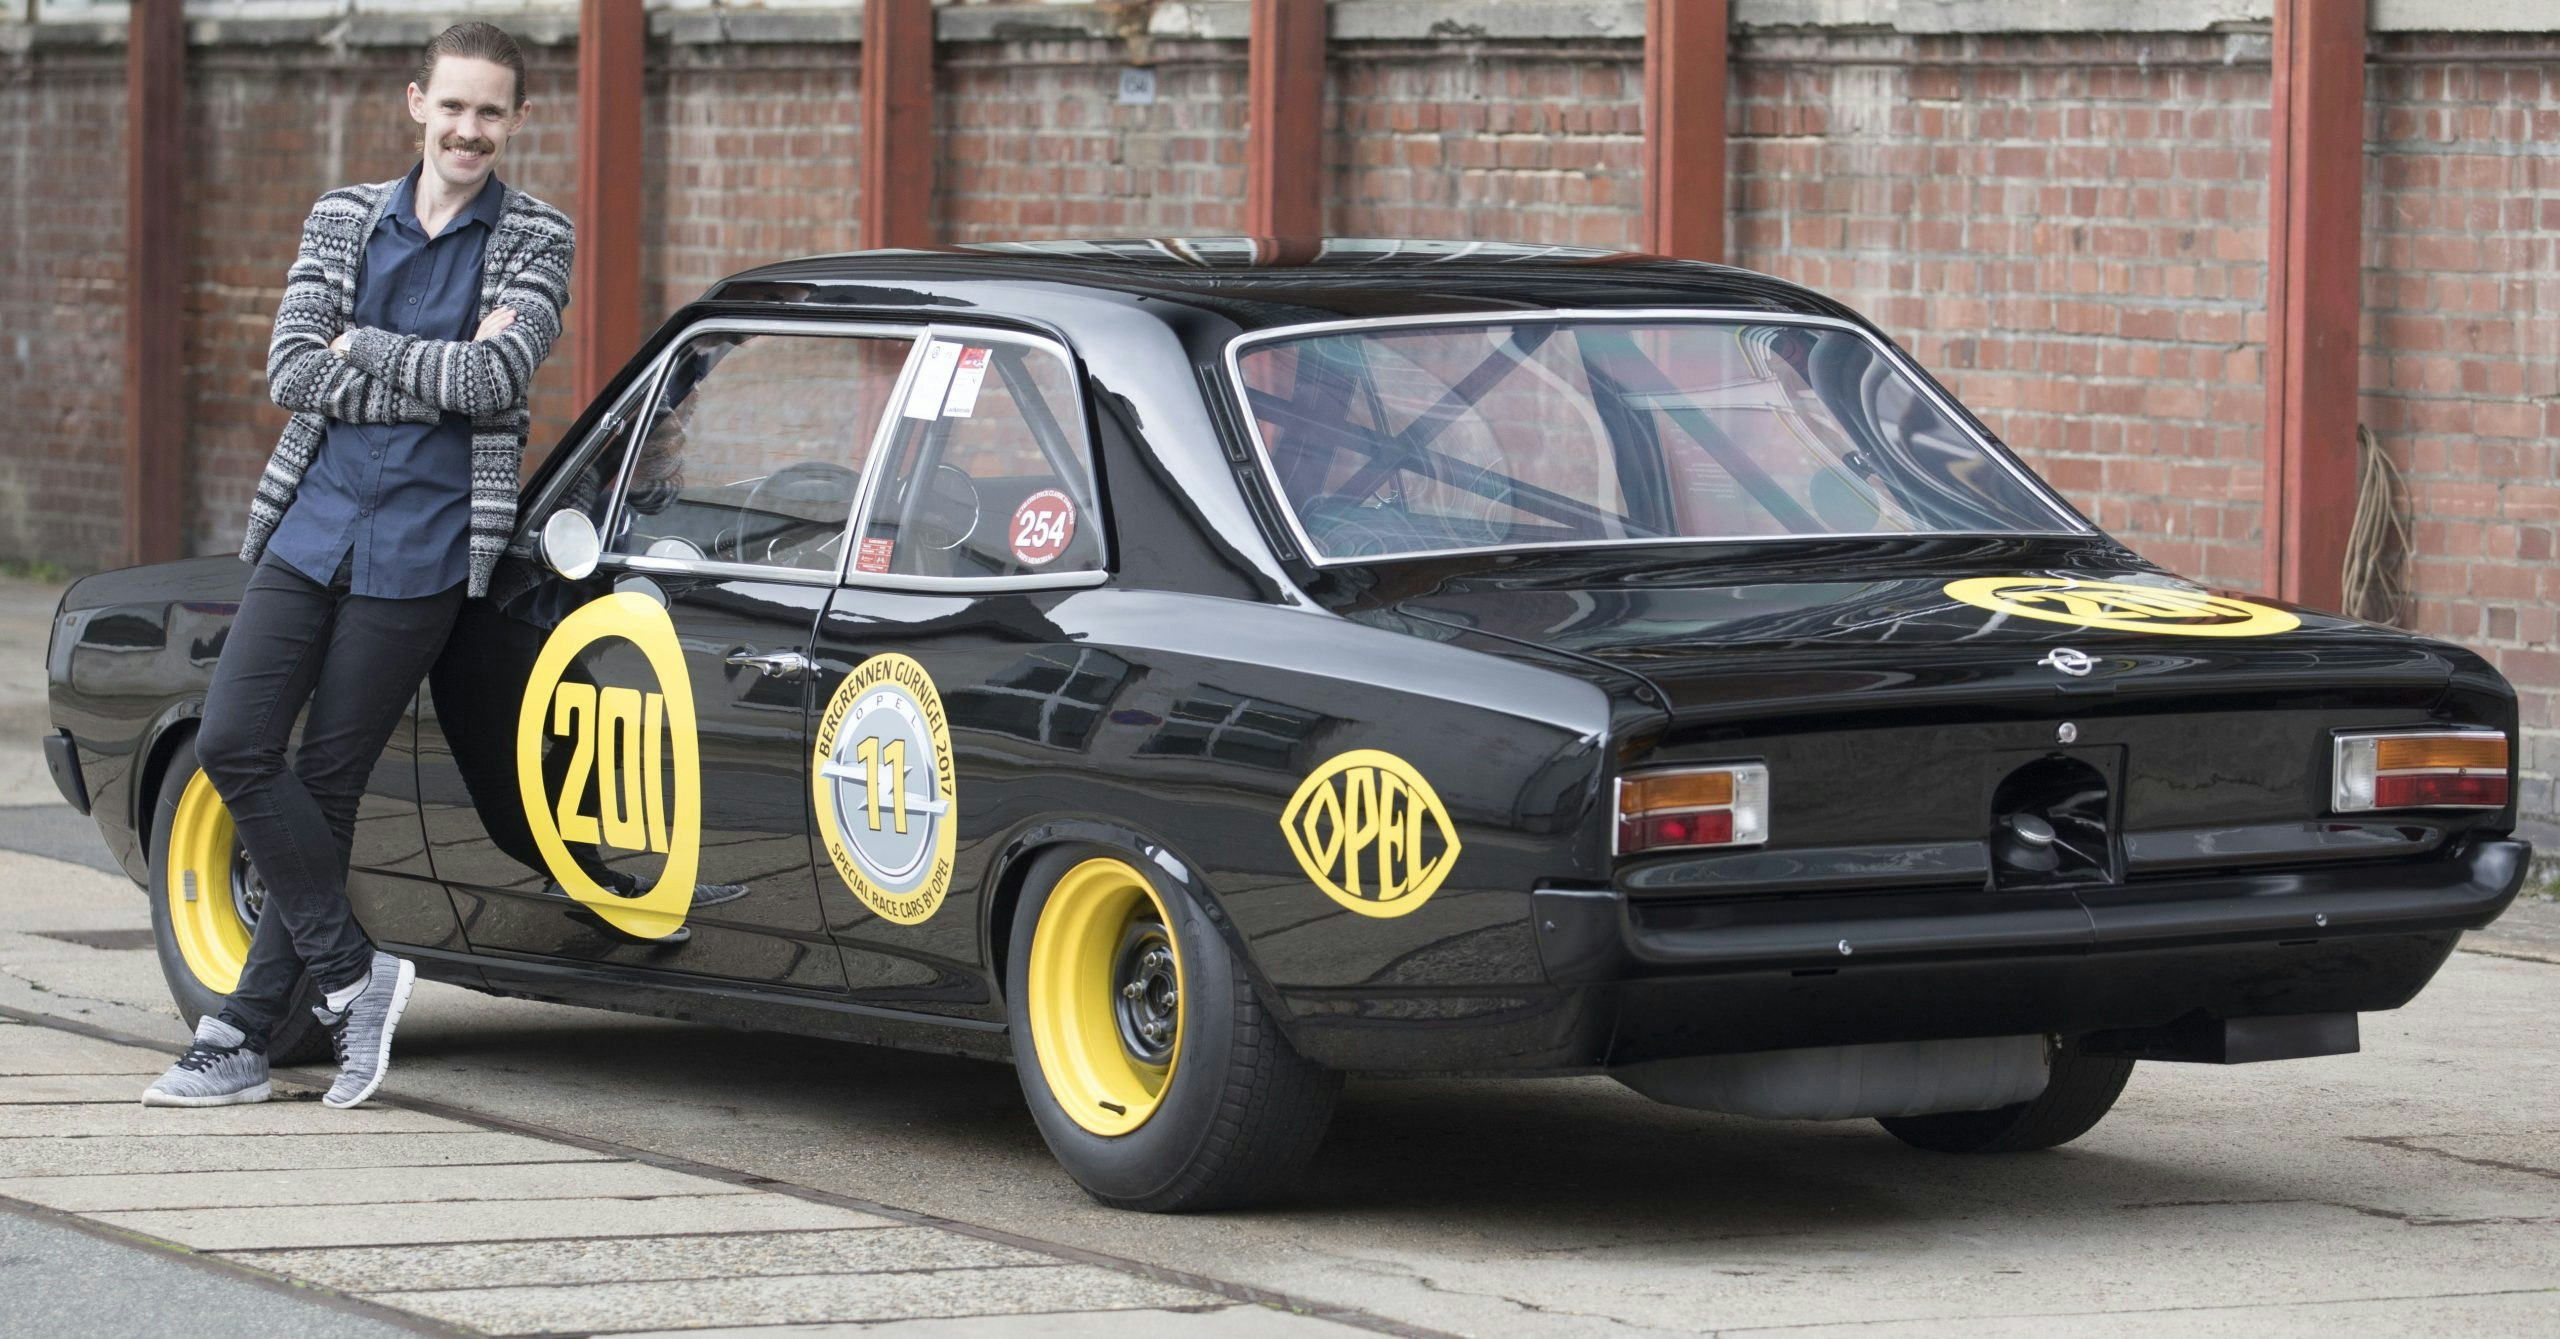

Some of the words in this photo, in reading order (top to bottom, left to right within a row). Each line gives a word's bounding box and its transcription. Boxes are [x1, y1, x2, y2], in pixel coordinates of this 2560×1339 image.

[1015, 510, 1067, 548] 254
[819, 660, 893, 758] BERGRENNEN
[895, 661, 943, 739] GURNIGEL
[936, 740, 953, 796] 2017
[855, 695, 916, 729] OPEL
[554, 681, 669, 854] 201
[856, 735, 908, 835] 11
[832, 843, 869, 900] SPECIAL
[872, 891, 899, 917] RACE
[900, 898, 925, 918] CARS
[923, 887, 935, 909] BY
[932, 858, 949, 895] OPEL
[1303, 767, 1437, 901] OPEL
